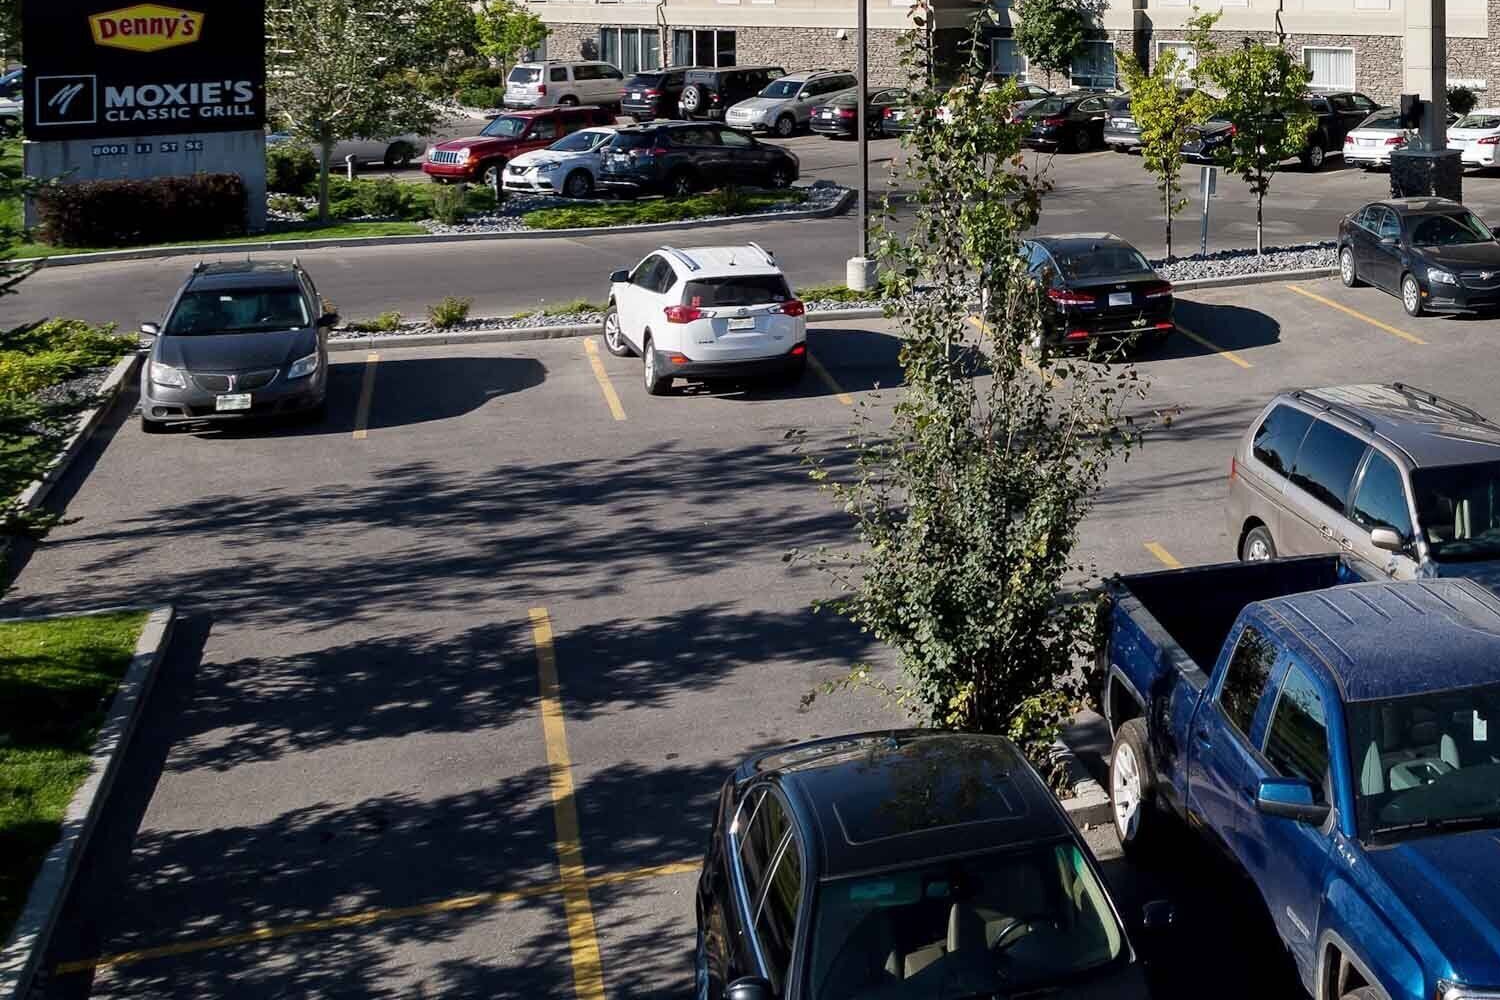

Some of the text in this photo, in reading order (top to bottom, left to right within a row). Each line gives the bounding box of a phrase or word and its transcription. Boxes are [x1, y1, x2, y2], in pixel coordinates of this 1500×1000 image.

[98, 13, 195, 40] Denny's
[104, 80, 254, 108] MOXIE'S
[105, 104, 255, 122] CLASSIC GRILL
[160, 142, 178, 152] ST
